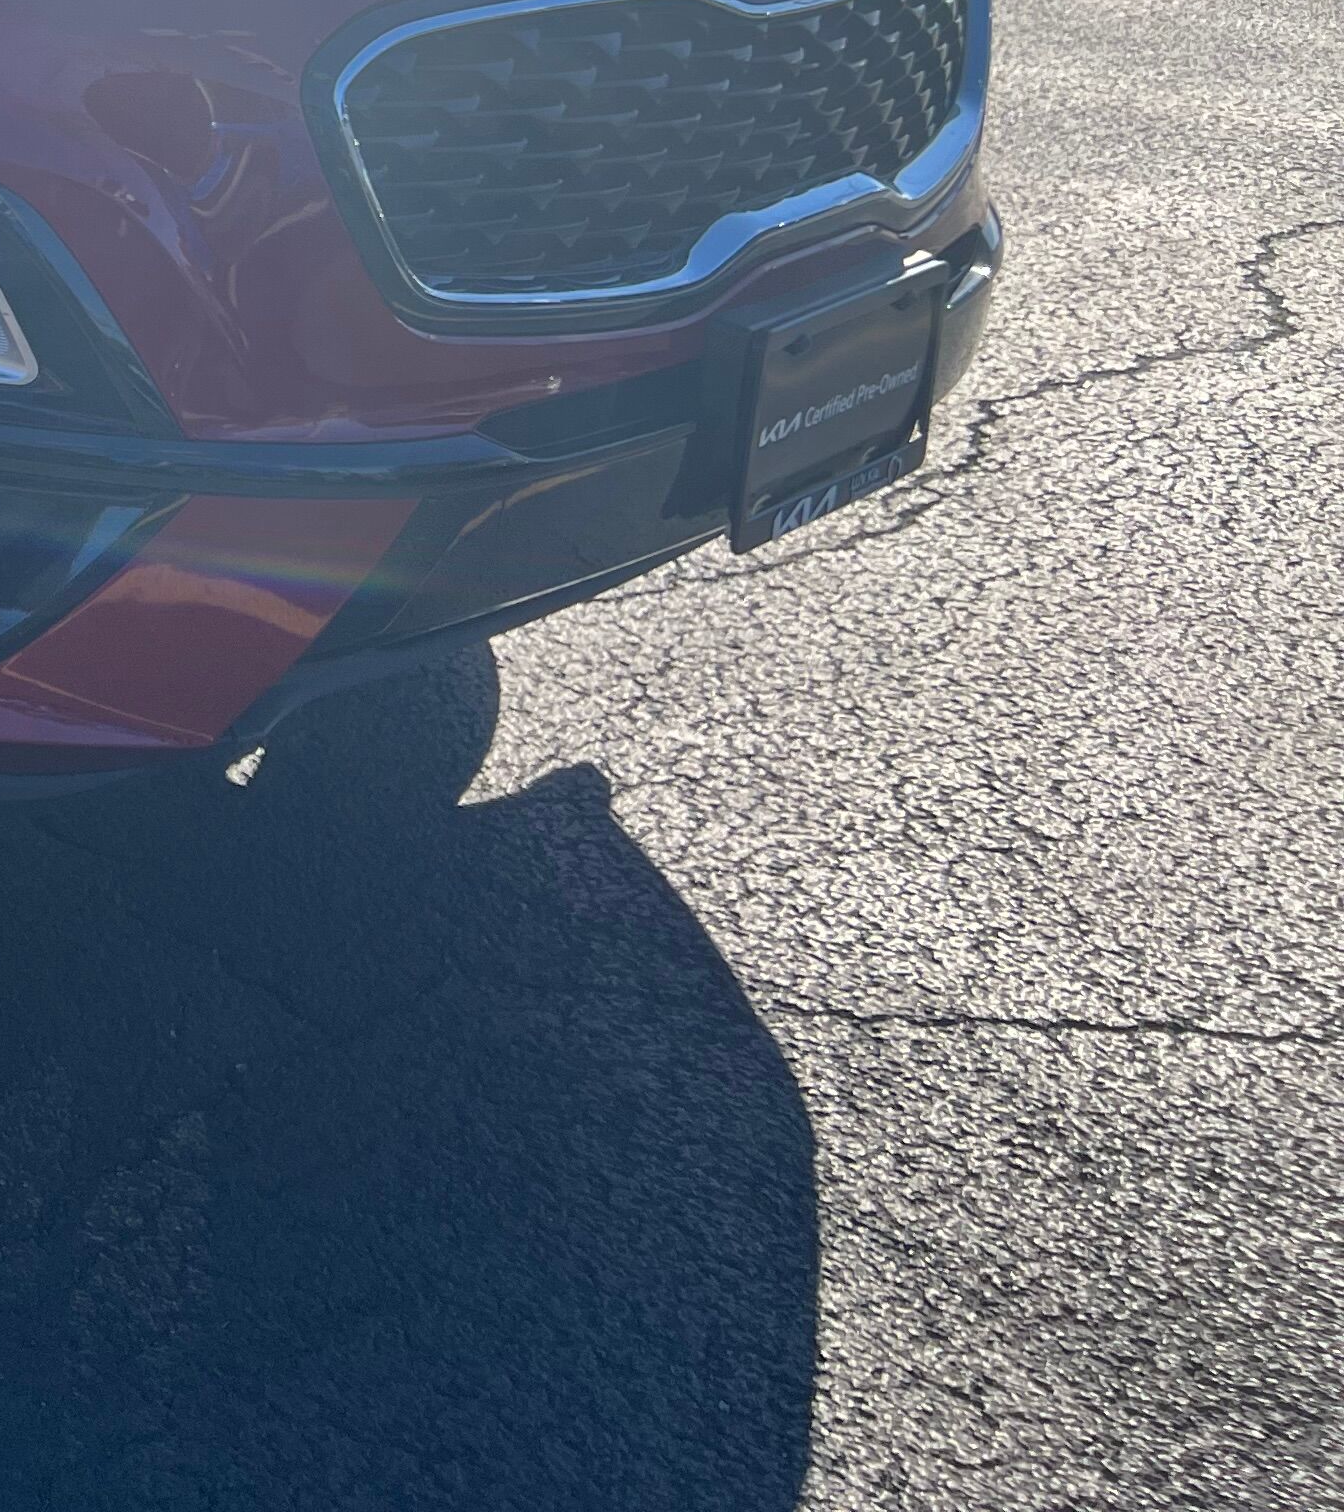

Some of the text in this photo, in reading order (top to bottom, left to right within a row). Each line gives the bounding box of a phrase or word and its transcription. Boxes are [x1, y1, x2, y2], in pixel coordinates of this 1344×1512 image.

[758, 361, 919, 448] KIA Certified Pre-Owned
[772, 484, 839, 540] KIA
